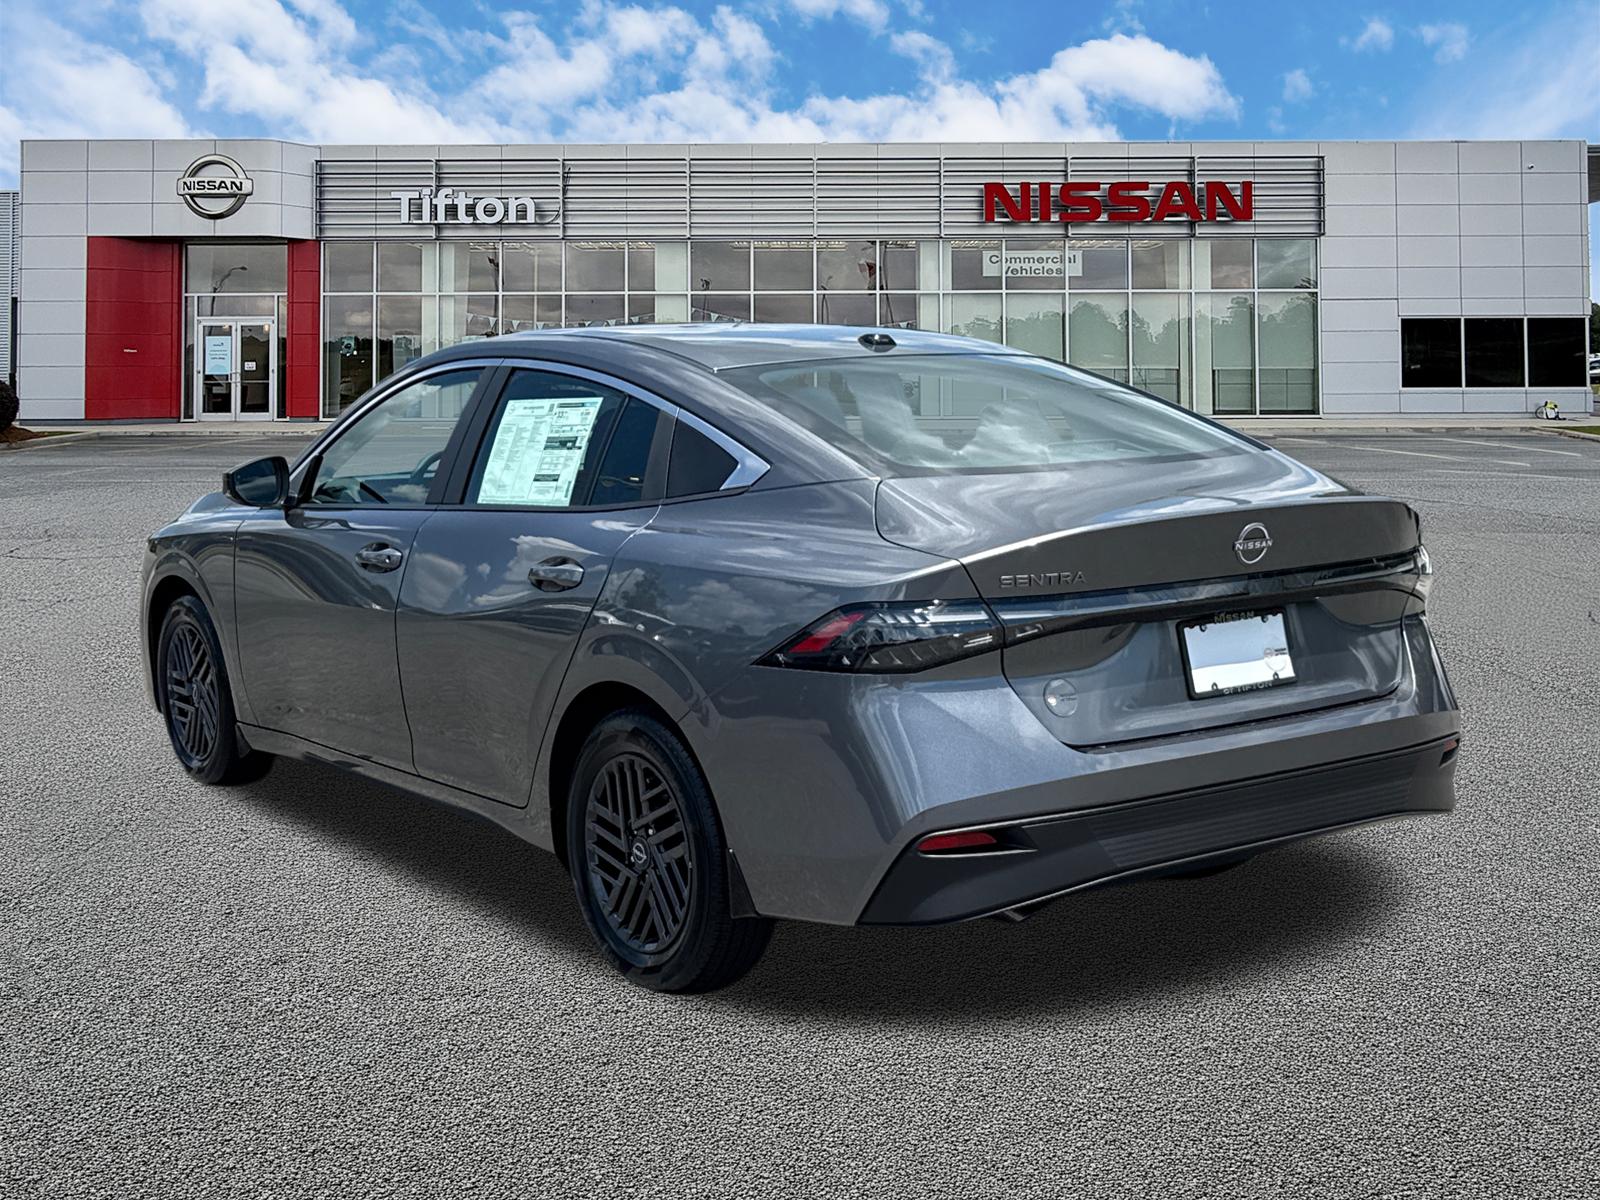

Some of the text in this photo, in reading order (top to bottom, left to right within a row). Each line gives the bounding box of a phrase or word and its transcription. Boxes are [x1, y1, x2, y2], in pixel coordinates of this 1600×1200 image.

[182, 180, 243, 191] NISSAN
[391, 188, 536, 224] Tifton
[983, 181, 1254, 222] NISSAN
[1235, 540, 1273, 550] NISSAN
[1000, 571, 1087, 588] SENTRA
